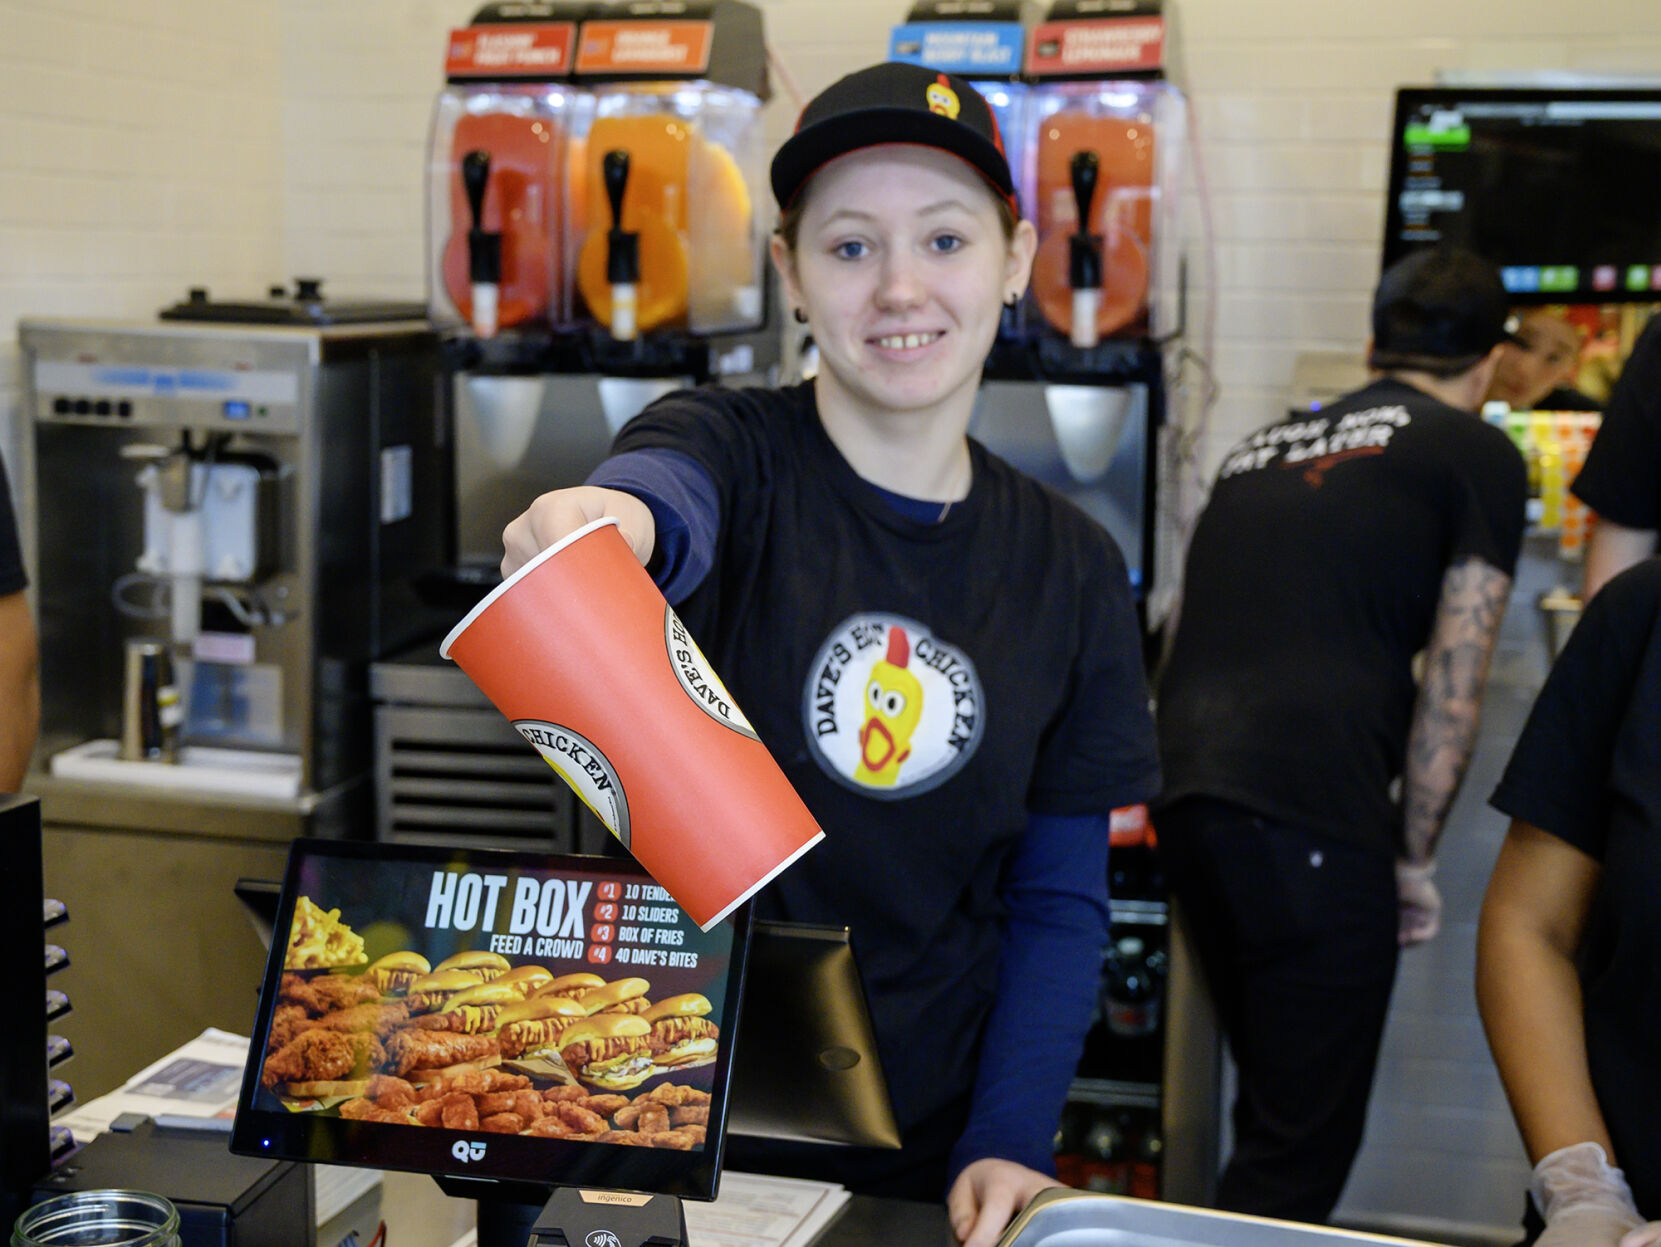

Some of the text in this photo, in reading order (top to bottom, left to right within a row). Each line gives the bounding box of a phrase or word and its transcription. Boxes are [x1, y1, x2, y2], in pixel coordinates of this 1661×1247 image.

[676, 649, 731, 719] DAVE'S
[817, 639, 976, 753] DAVE'S CHICKEN
[522, 728, 613, 791] CHICKEN
[603, 883, 615, 899] #1
[625, 884, 640, 900] 10
[424, 871, 593, 939] HOT BOX
[600, 904, 679, 923] #2 10 SLIDERS
[489, 934, 585, 960] FEED A CROWD
[597, 926, 685, 946] #3 BOX OF FRIES
[593, 947, 699, 968] #4 40 DAVE'S BITES
[597, 1193, 632, 1203] ingenico
